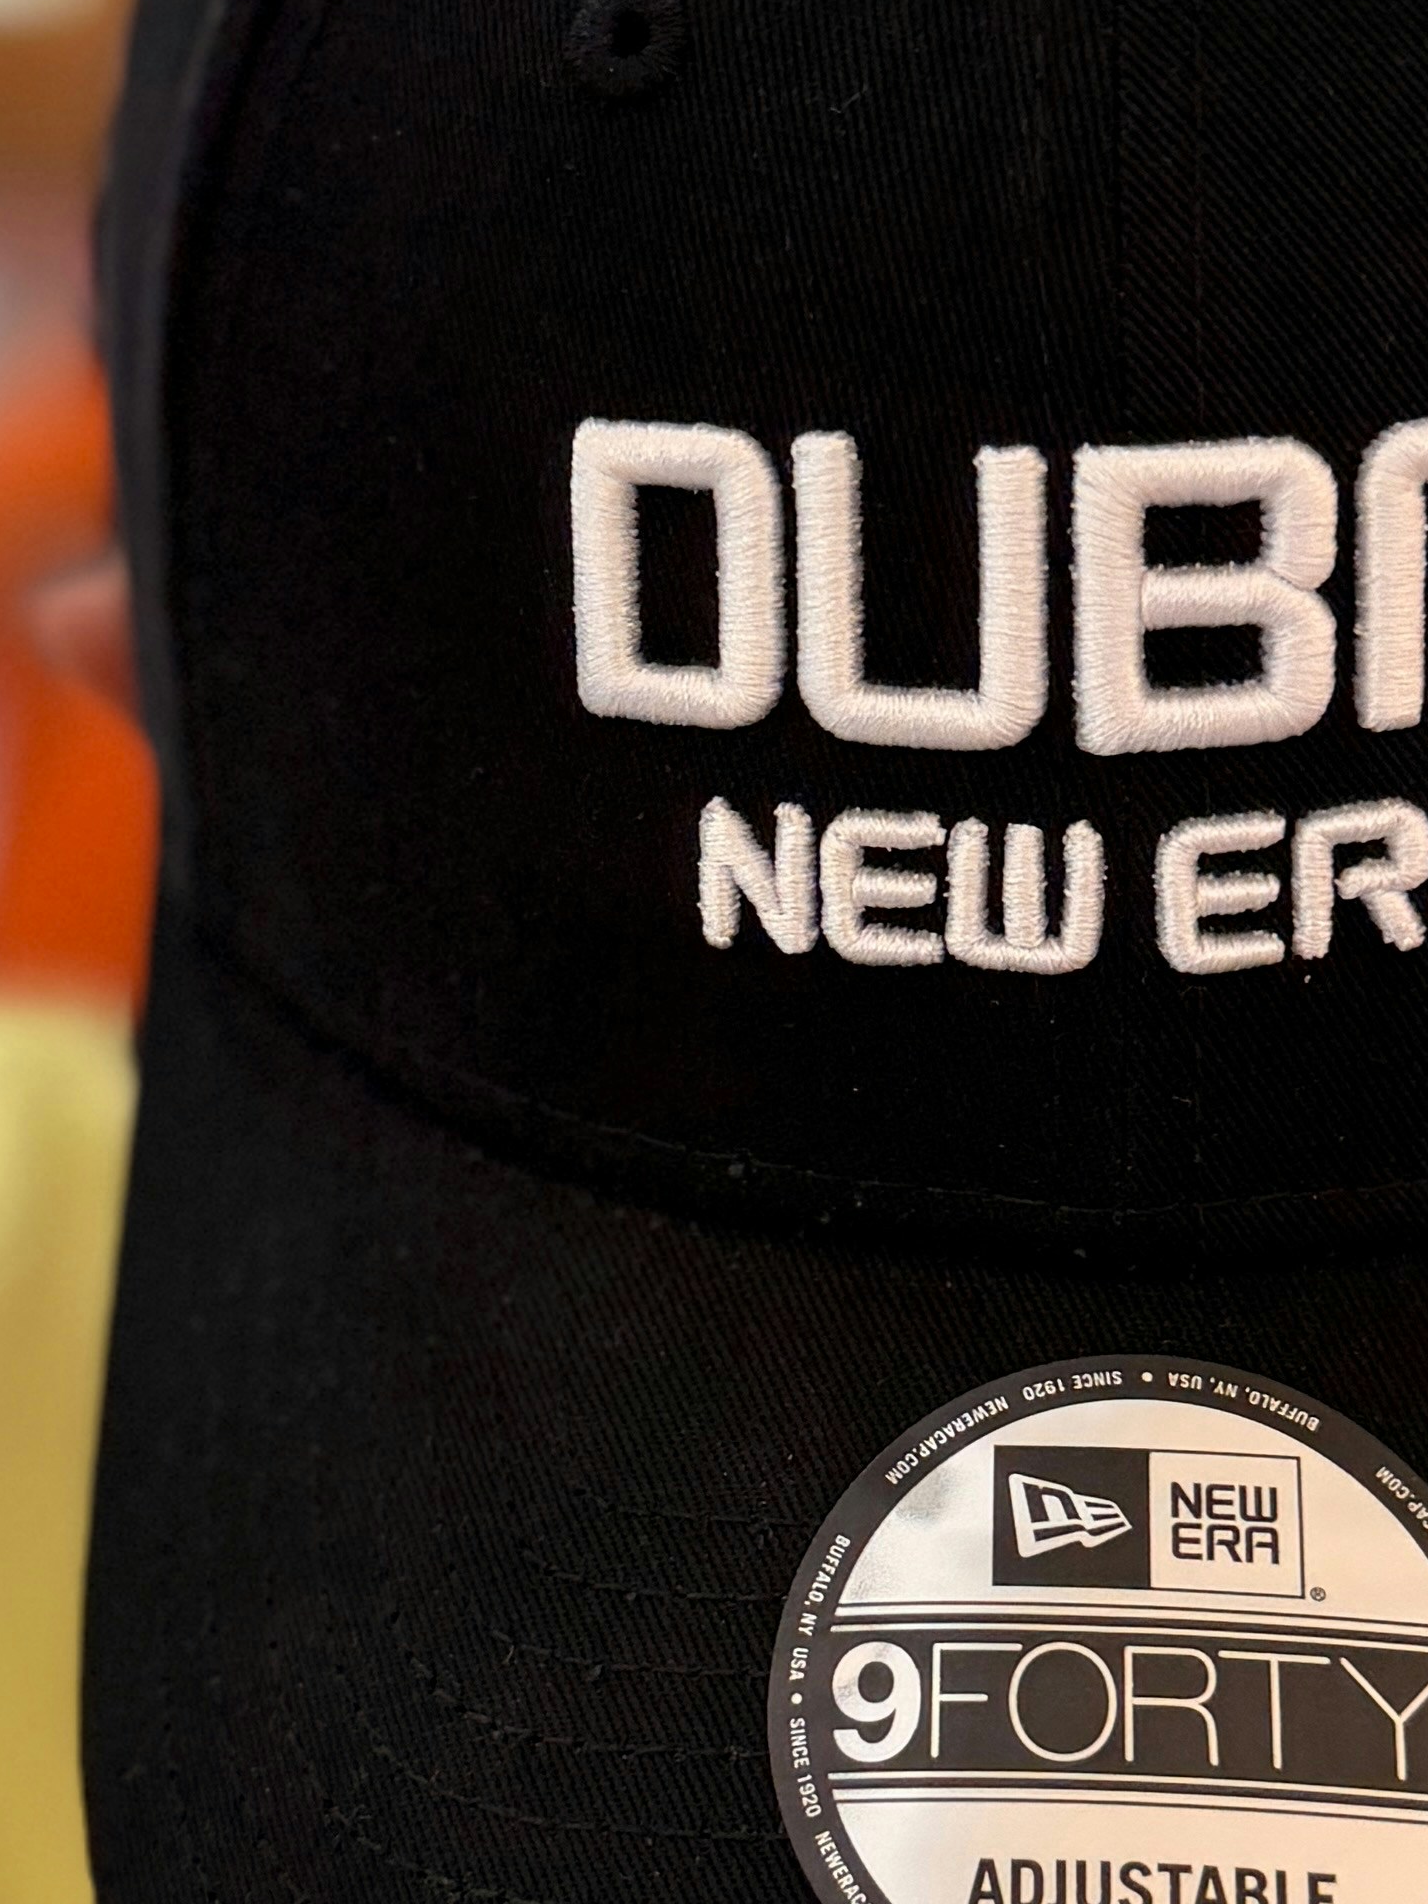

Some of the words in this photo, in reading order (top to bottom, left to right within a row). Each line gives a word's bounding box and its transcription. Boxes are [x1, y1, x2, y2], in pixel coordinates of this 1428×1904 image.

[697, 795, 1106, 974] NEW
[1022, 1378, 1066, 1401] 1920
[1071, 1370, 1123, 1390] SINCE
[1167, 1371, 1202, 1390] USA
[1244, 1386, 1320, 1432] BUFFALO,
[885, 1396, 1009, 1485] NEWERACAP.COM
[1170, 1481, 1277, 1523] NEW
[1171, 1522, 1280, 1565] ERA
[804, 1534, 851, 1606] BUFFALO,
[789, 1647, 809, 1681] USA
[790, 1717, 810, 1769] SINCE
[797, 1774, 822, 1817] 1920
